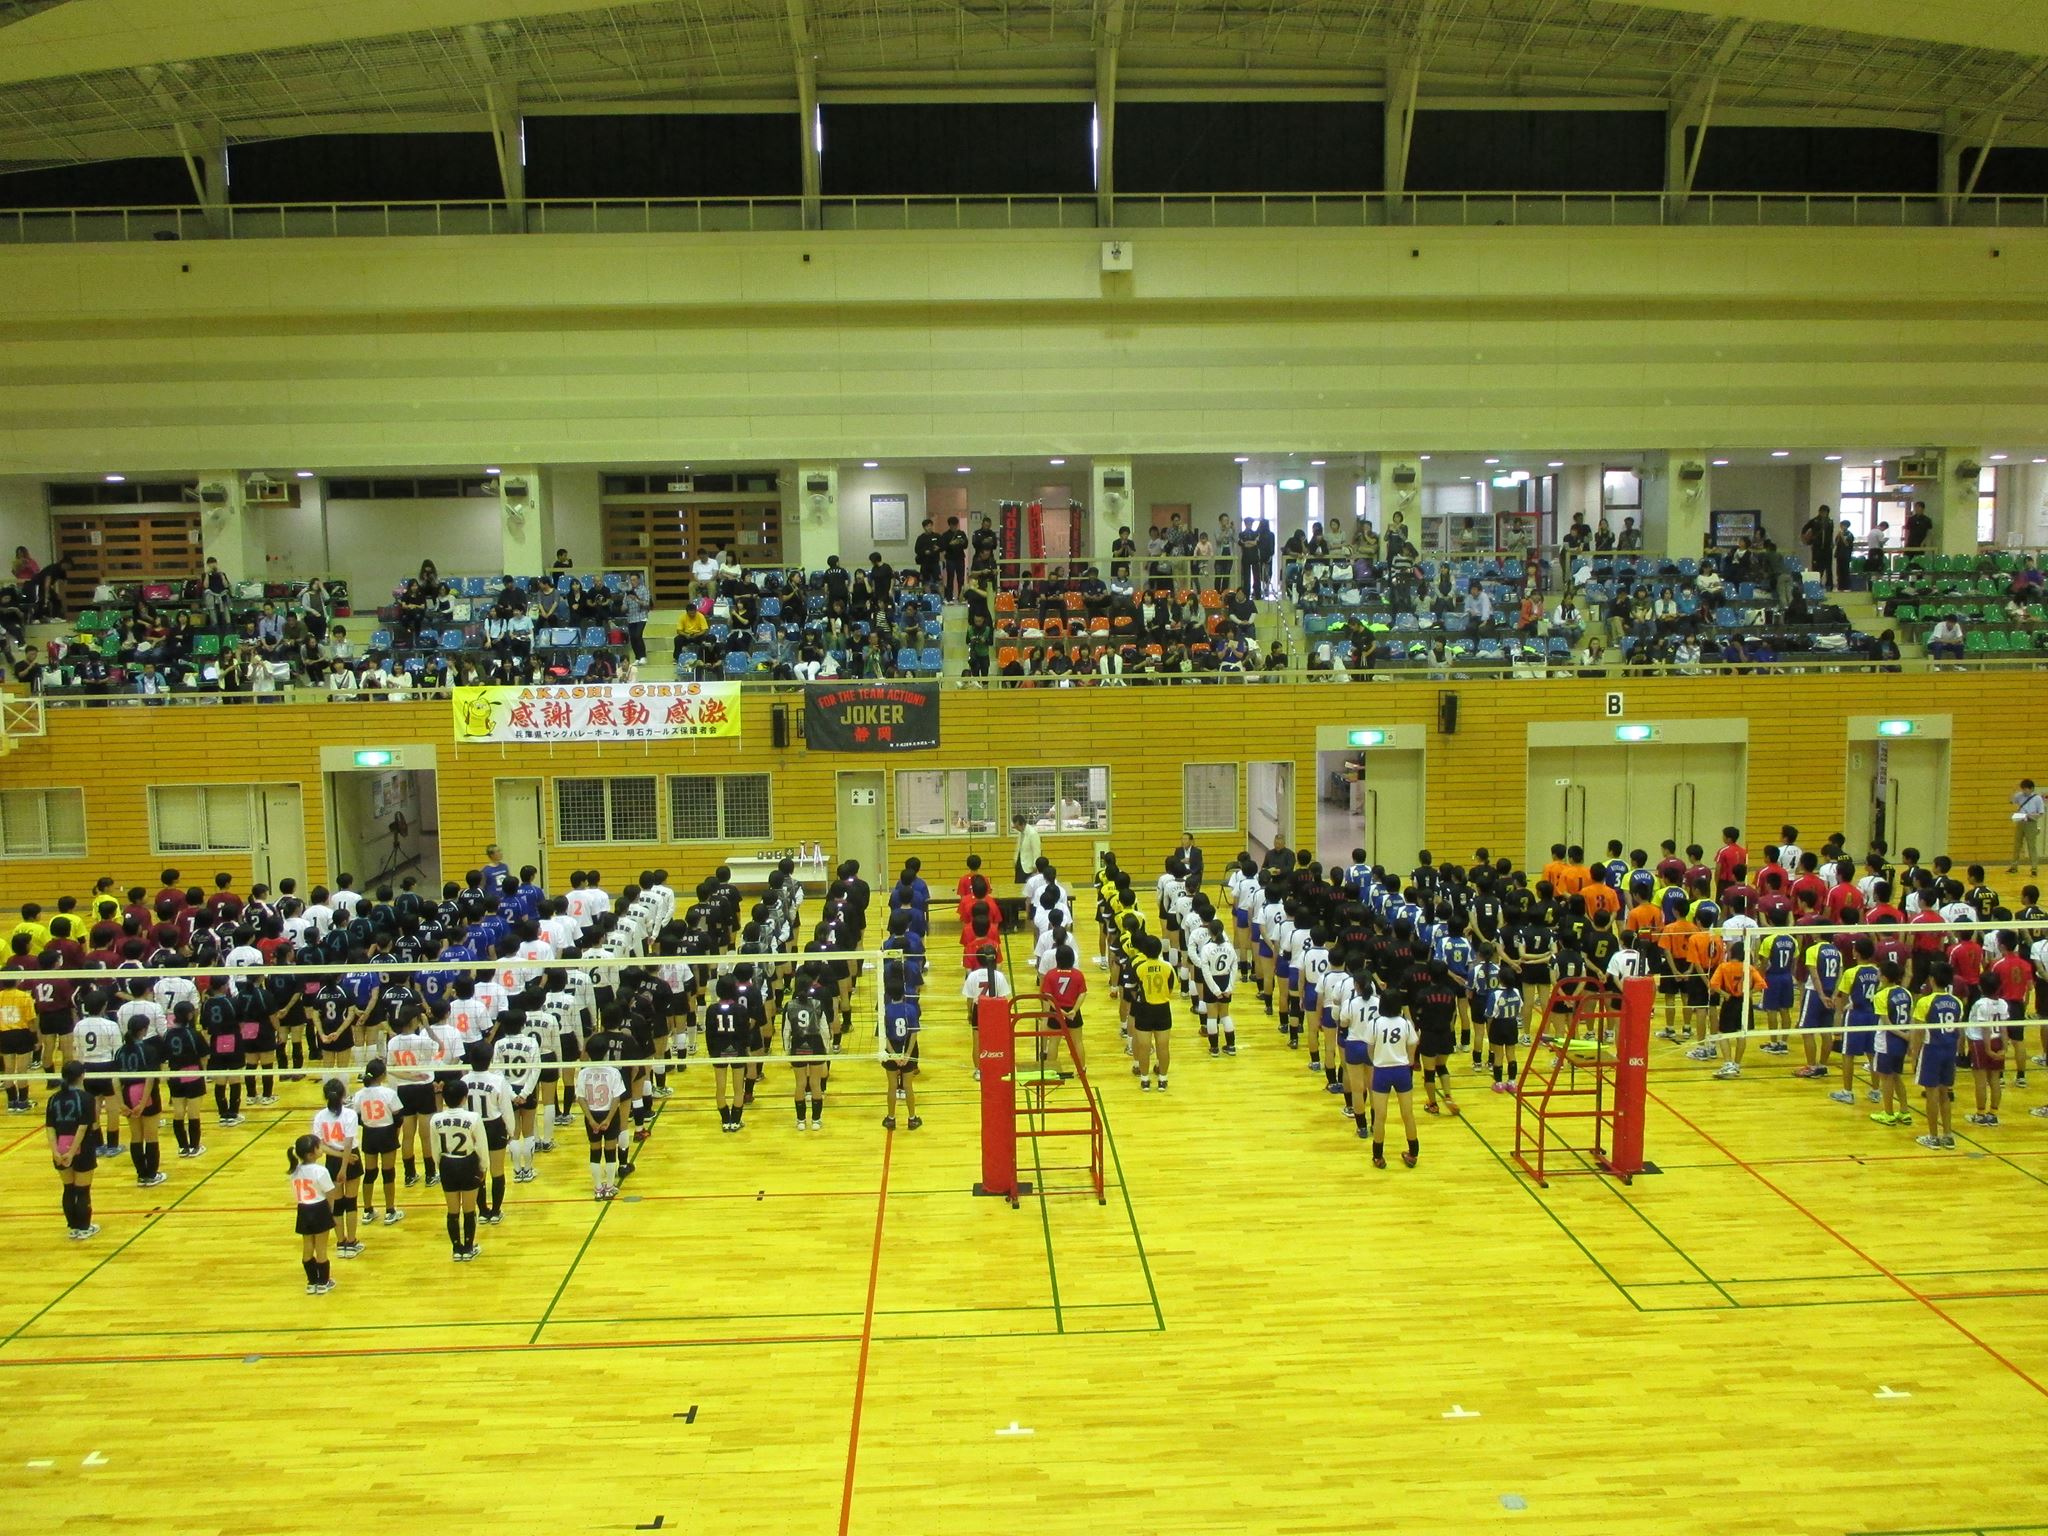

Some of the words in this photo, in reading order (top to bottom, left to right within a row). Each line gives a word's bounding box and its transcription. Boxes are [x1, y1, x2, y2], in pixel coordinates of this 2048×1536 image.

[520, 686, 612, 699] AKASHI
[629, 683, 702, 698] GIRLS
[858, 688, 885, 700] TEAM
[508, 701, 573, 729] 感謝
[586, 699, 650, 728] 感動
[664, 697, 728, 725] 感激
[1608, 694, 1621, 714] B
[840, 704, 904, 725] JOKER
[1789, 855, 1796, 869] 4
[1614, 872, 1622, 887] 3
[504, 909, 515, 924] 2
[573, 900, 583, 916] 2
[1982, 900, 1991, 915] 5
[251, 915, 261, 931] 2
[356, 925, 365, 939] 3
[224, 935, 234, 950] 3
[289, 929, 297, 945] 2
[330, 936, 340, 950] 4
[1302, 938, 1312, 951] 8
[468, 938, 478, 955] 4
[1595, 940, 1609, 957] 6
[402, 949, 413, 963] 5
[1216, 954, 1228, 972] 6
[1454, 950, 1462, 963] 8
[1779, 949, 1790, 968] 17
[590, 966, 602, 984] 6
[1310, 959, 1328, 974] 10
[1825, 958, 1838, 977] 12
[350, 979, 361, 997] 7
[426, 976, 438, 994] 6
[502, 970, 514, 988] 6
[1058, 977, 1071, 995] 7
[1147, 974, 1164, 995] 19
[35, 983, 54, 1002] 12
[164, 991, 175, 1009] 7
[326, 1000, 337, 1020] 8
[391, 1001, 402, 1019] 7
[481, 995, 492, 1009] 7
[211, 1005, 223, 1024] 8
[797, 1010, 810, 1028] 9
[1503, 1005, 1516, 1019] 11
[1896, 1004, 1908, 1024] 15
[456, 1013, 469, 1033] 8
[716, 1014, 735, 1032] 11
[895, 1017, 907, 1037] 8
[85, 1031, 97, 1052] 9
[1382, 1027, 1401, 1045] 18
[170, 1036, 183, 1055] 9
[394, 1050, 416, 1066] 10
[502, 1054, 527, 1078] 10
[584, 1083, 610, 1106] 13
[53, 1099, 76, 1121] 12
[362, 1099, 385, 1121] 13
[321, 1121, 346, 1144] 14
[438, 1132, 467, 1156] 12
[293, 1178, 317, 1201] 15
